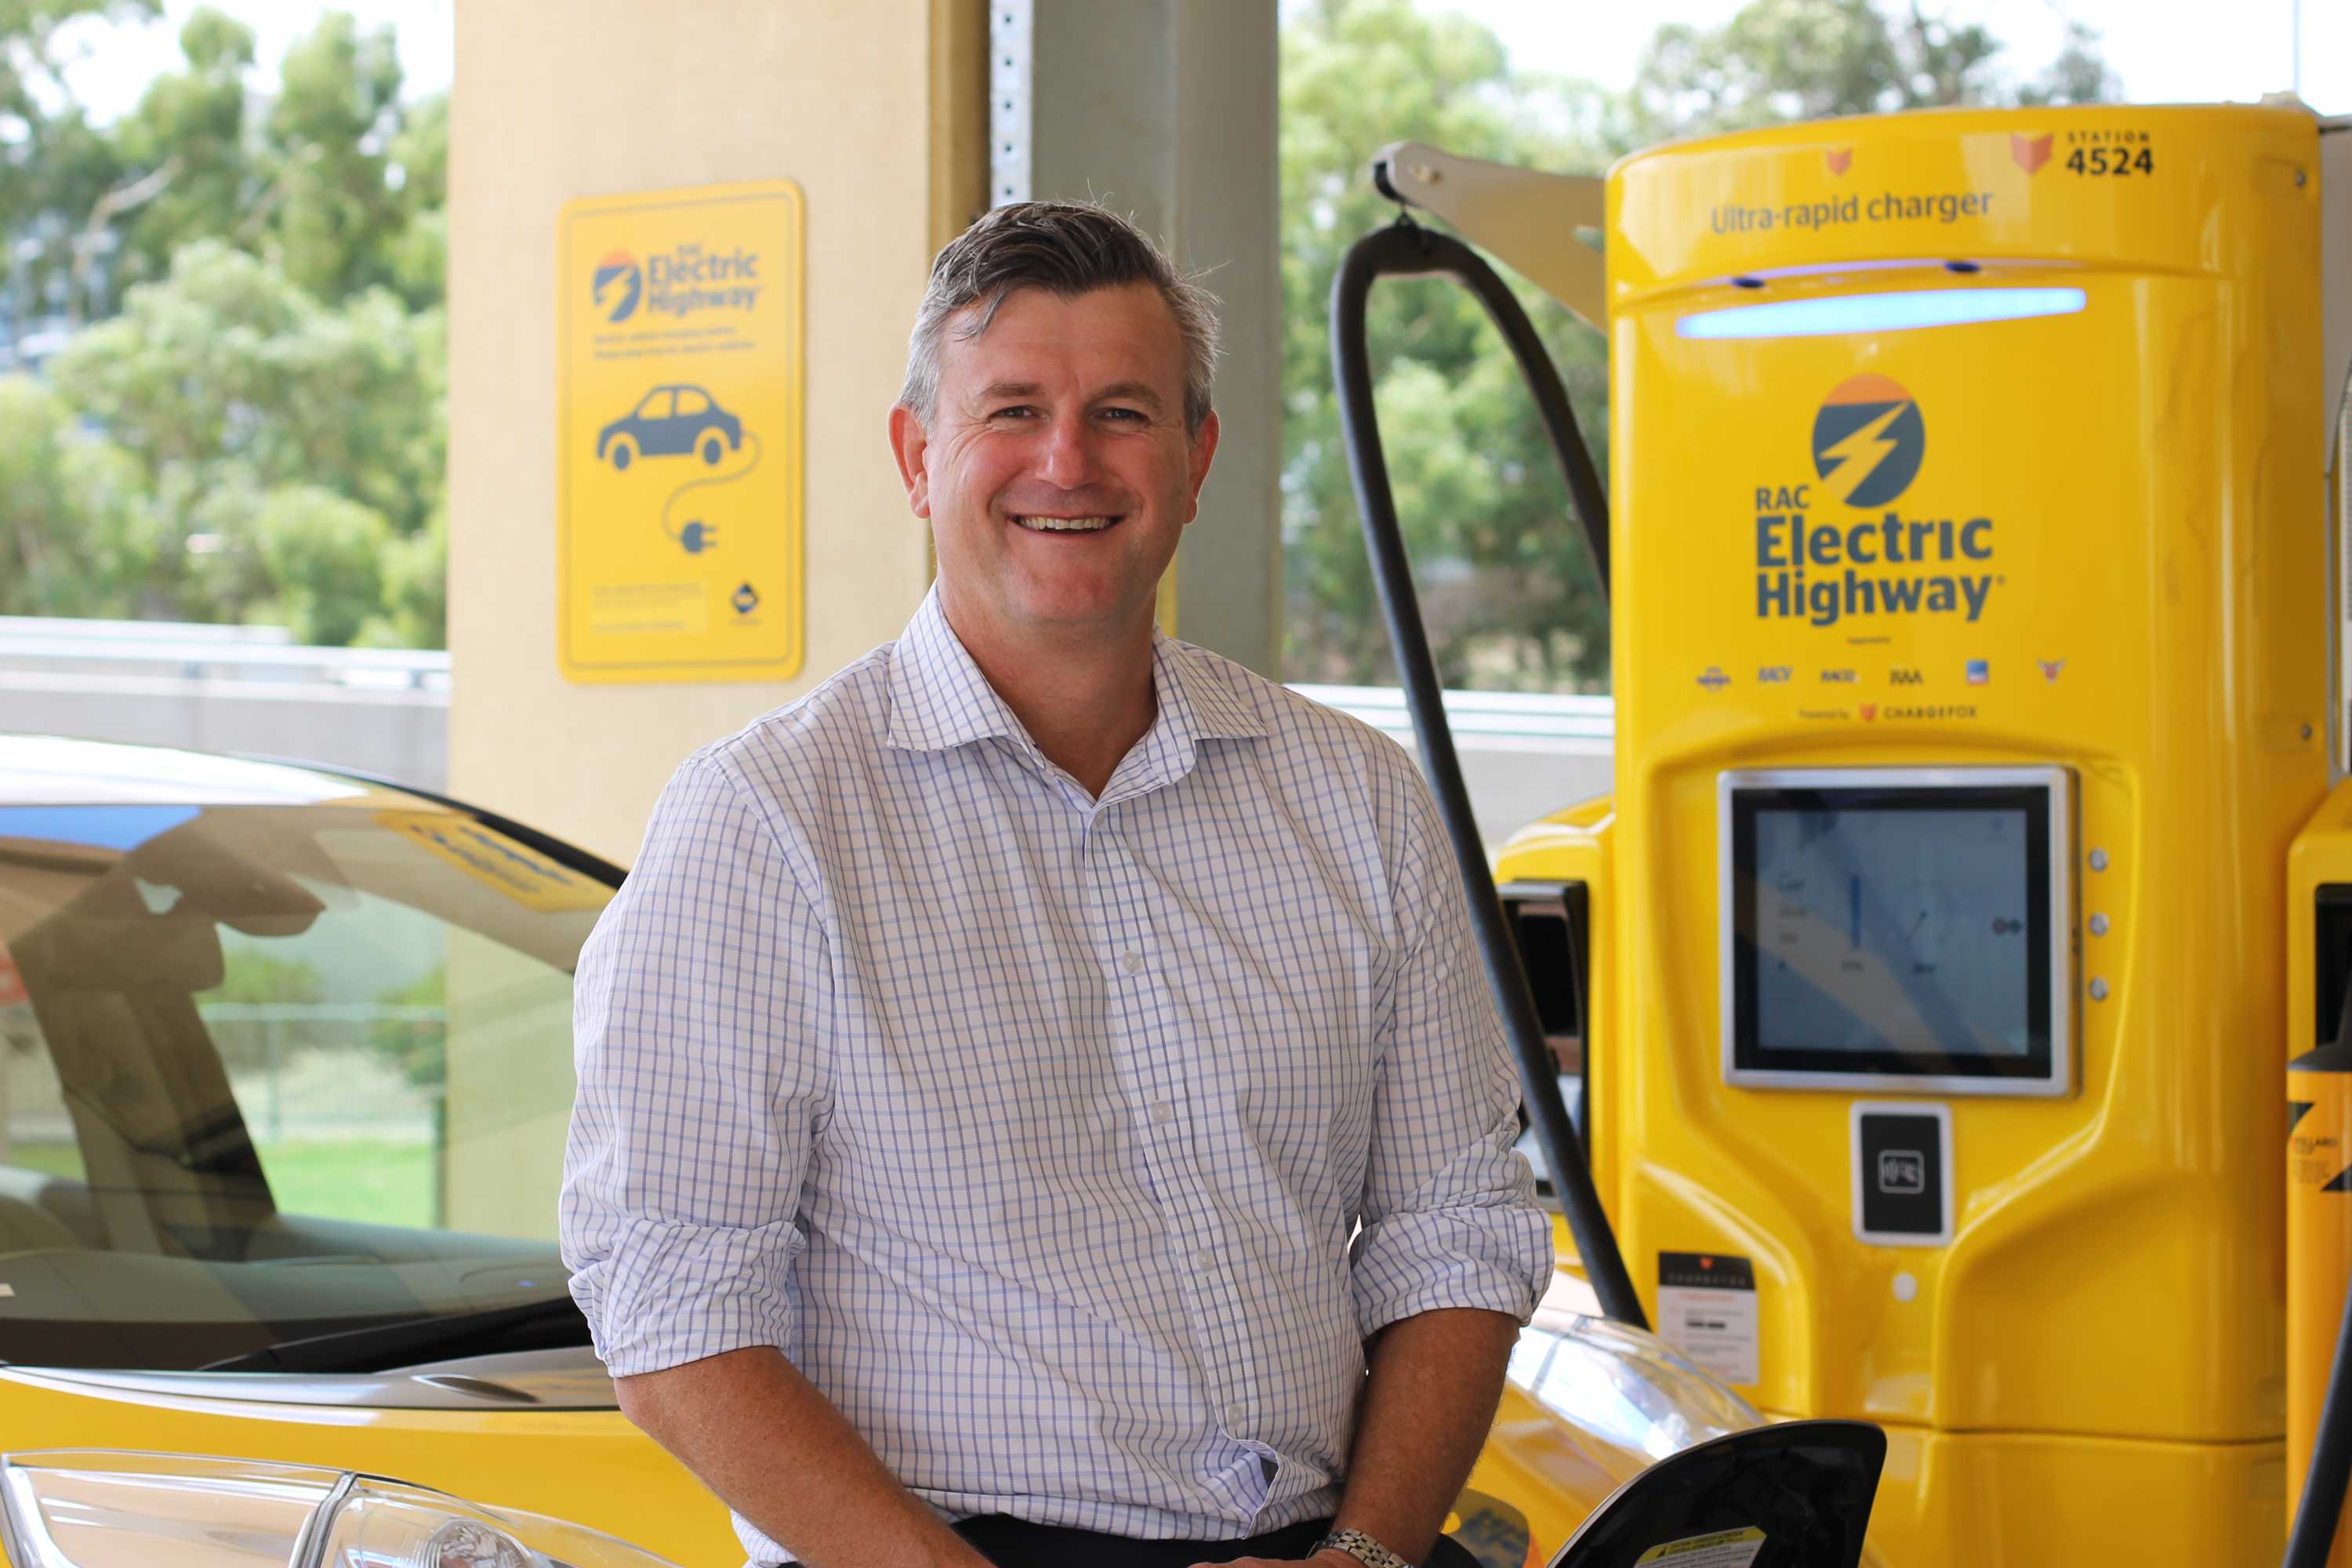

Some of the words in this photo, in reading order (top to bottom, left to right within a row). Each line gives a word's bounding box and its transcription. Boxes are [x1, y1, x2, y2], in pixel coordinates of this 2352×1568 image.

[2068, 130, 2150, 143] STATION
[2066, 147, 2154, 176] 4524
[1710, 194, 1858, 234] Ultra-rapid
[1867, 191, 1994, 223] charger
[648, 247, 759, 285] Electric
[648, 286, 761, 319] Highway
[1755, 485, 1810, 511] RAC
[1756, 512, 1994, 568] Electric
